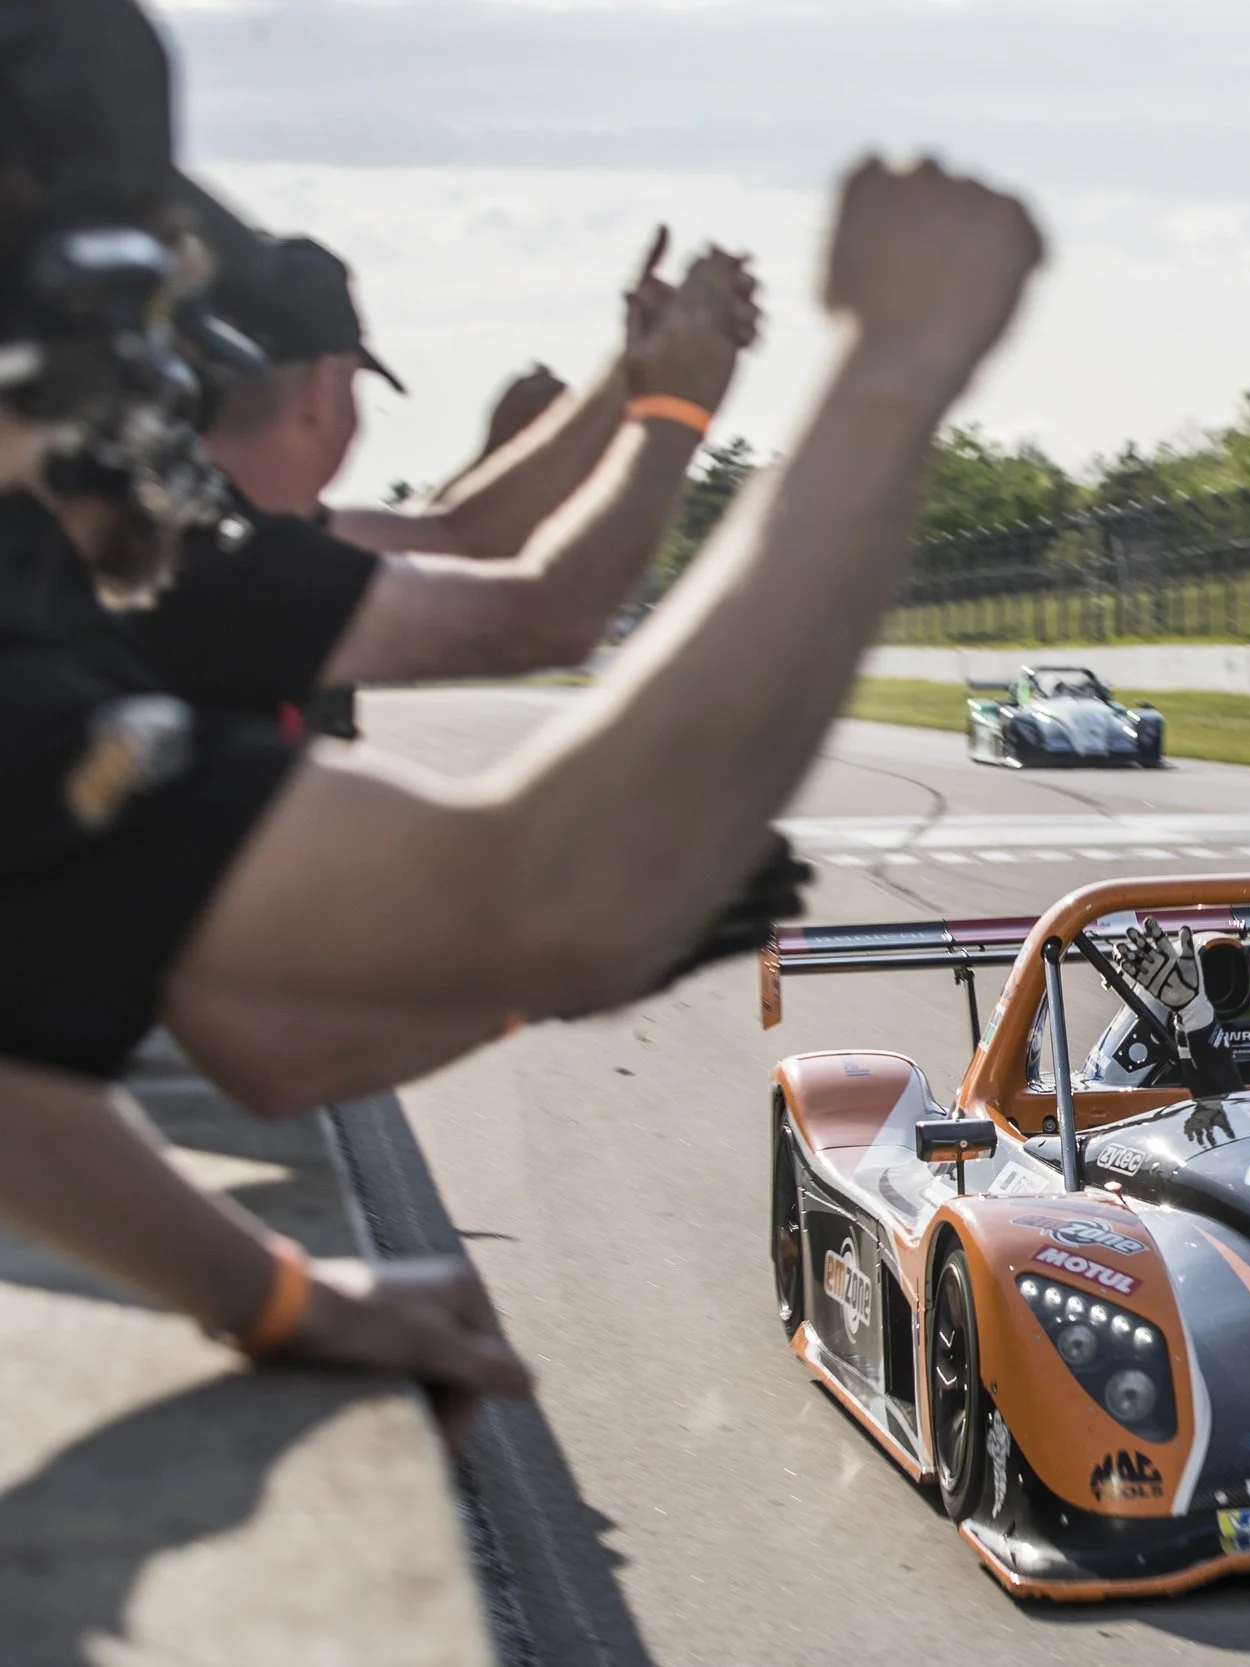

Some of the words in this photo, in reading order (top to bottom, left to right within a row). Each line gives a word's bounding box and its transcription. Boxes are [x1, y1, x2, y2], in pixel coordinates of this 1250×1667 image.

[825, 1252, 872, 1324] emzone
[1037, 1247, 1135, 1294] MOTUL
[1090, 1449, 1164, 1503] MAC
